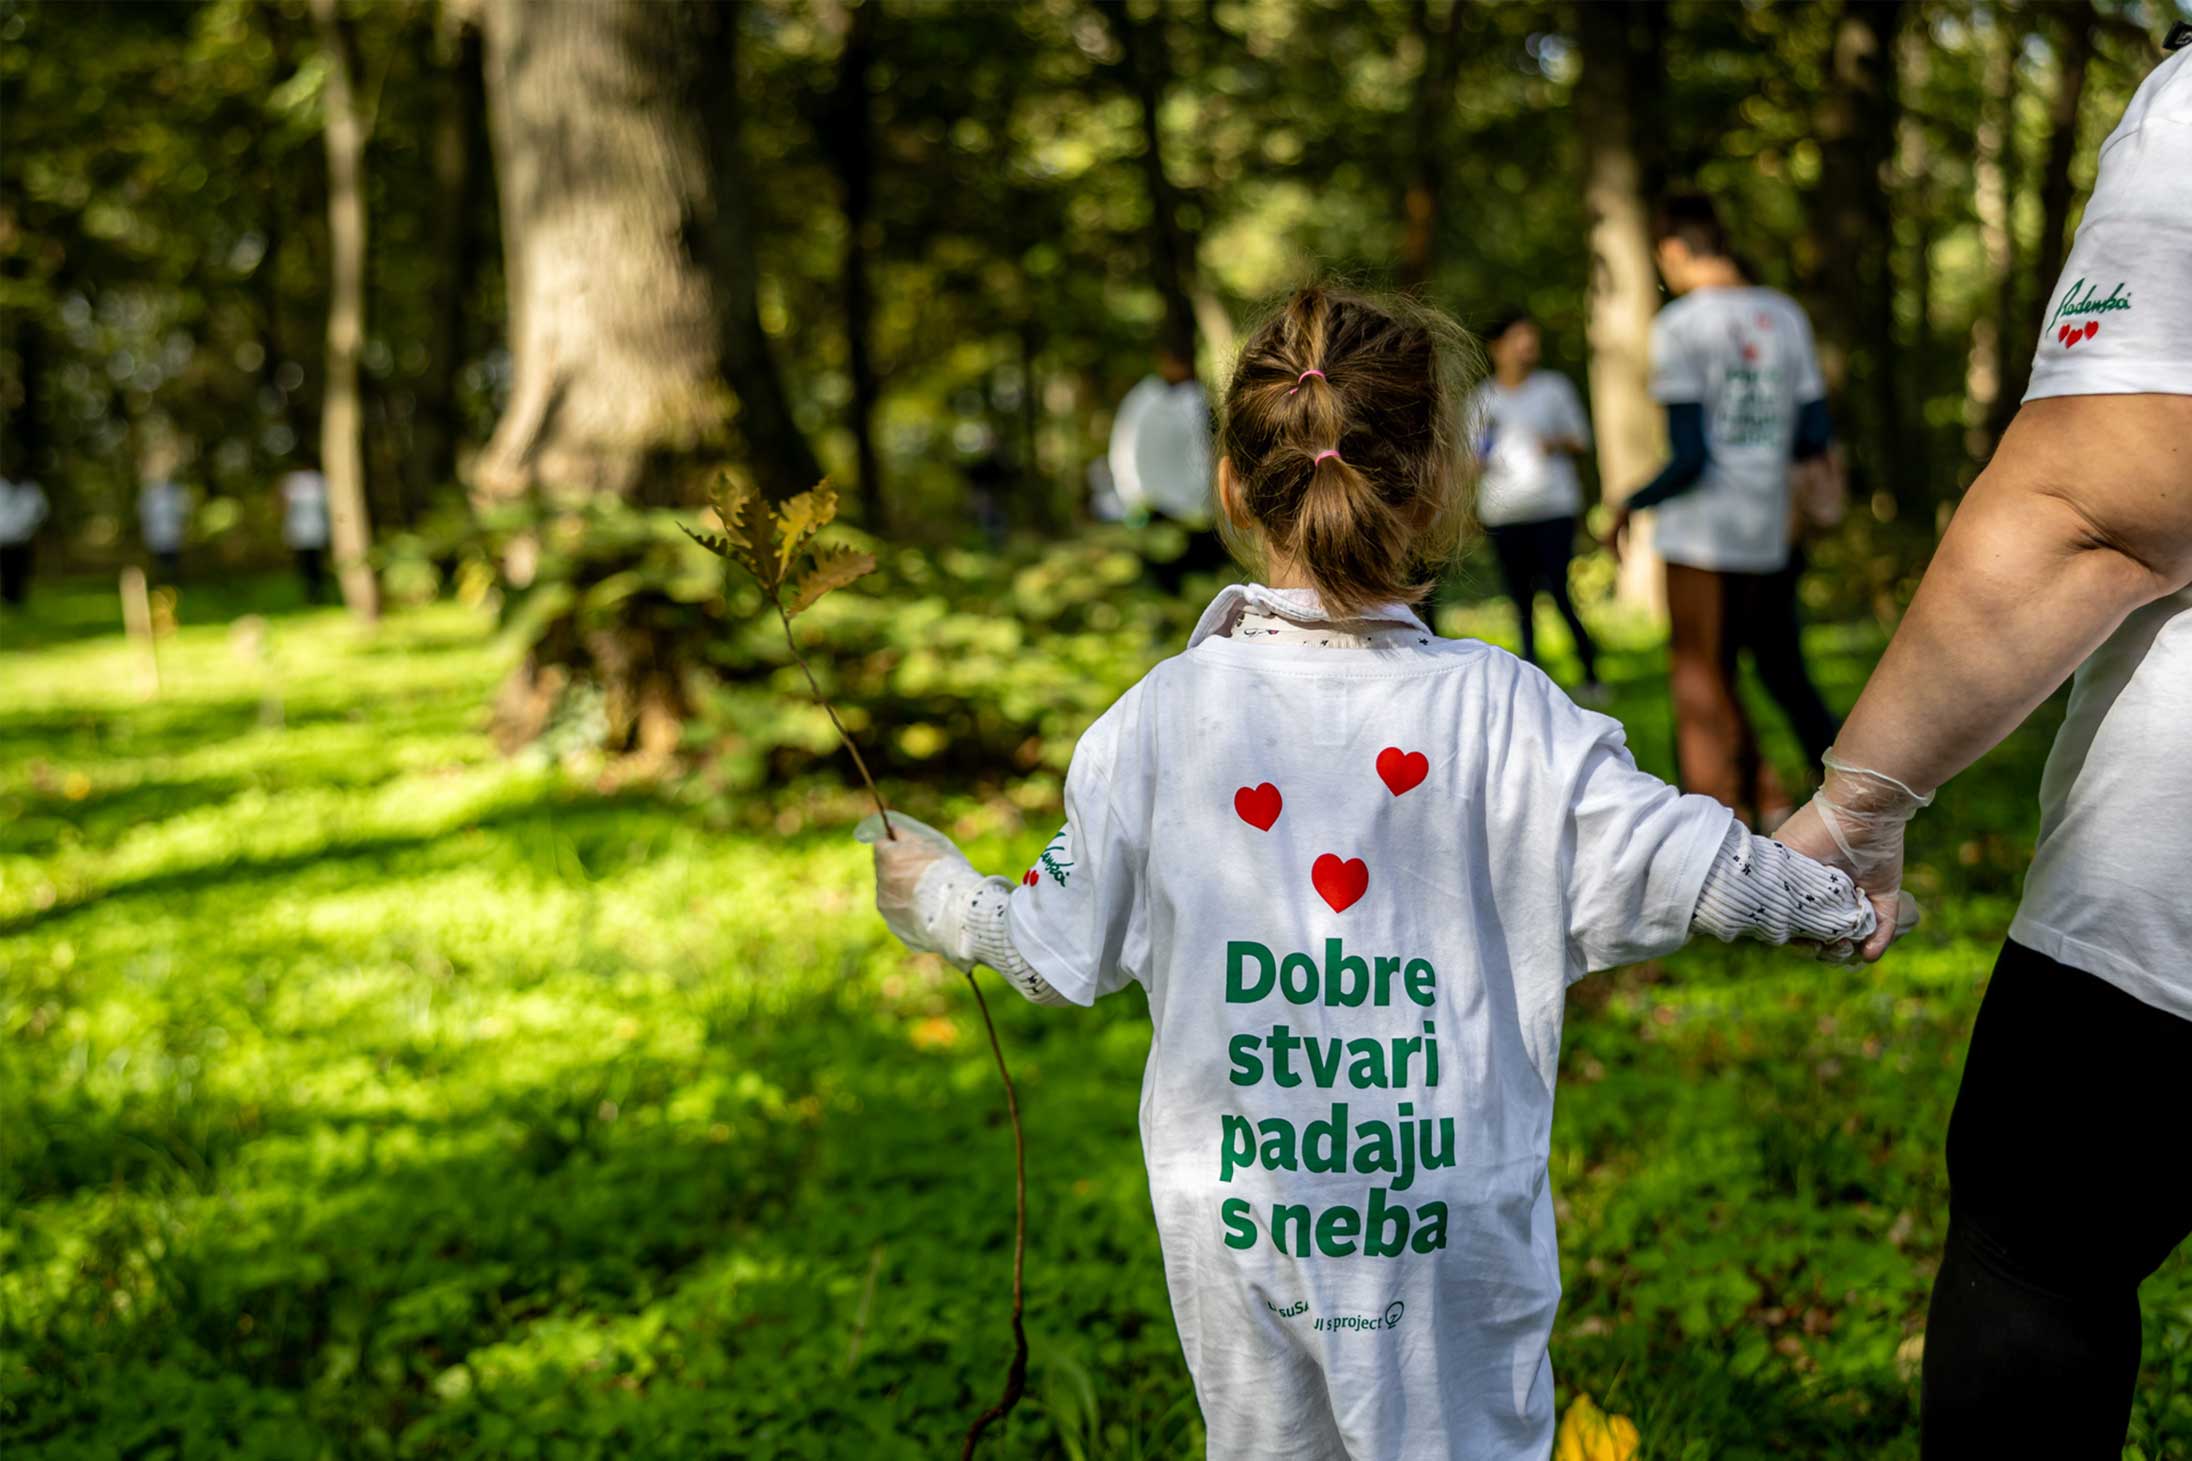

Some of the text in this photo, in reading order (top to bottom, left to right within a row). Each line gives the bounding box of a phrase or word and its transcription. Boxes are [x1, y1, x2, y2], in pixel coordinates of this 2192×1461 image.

[1225, 937, 1436, 1008] Dobre
[1228, 1020, 1440, 1089] stvari
[1219, 1101, 1456, 1191] padaju
